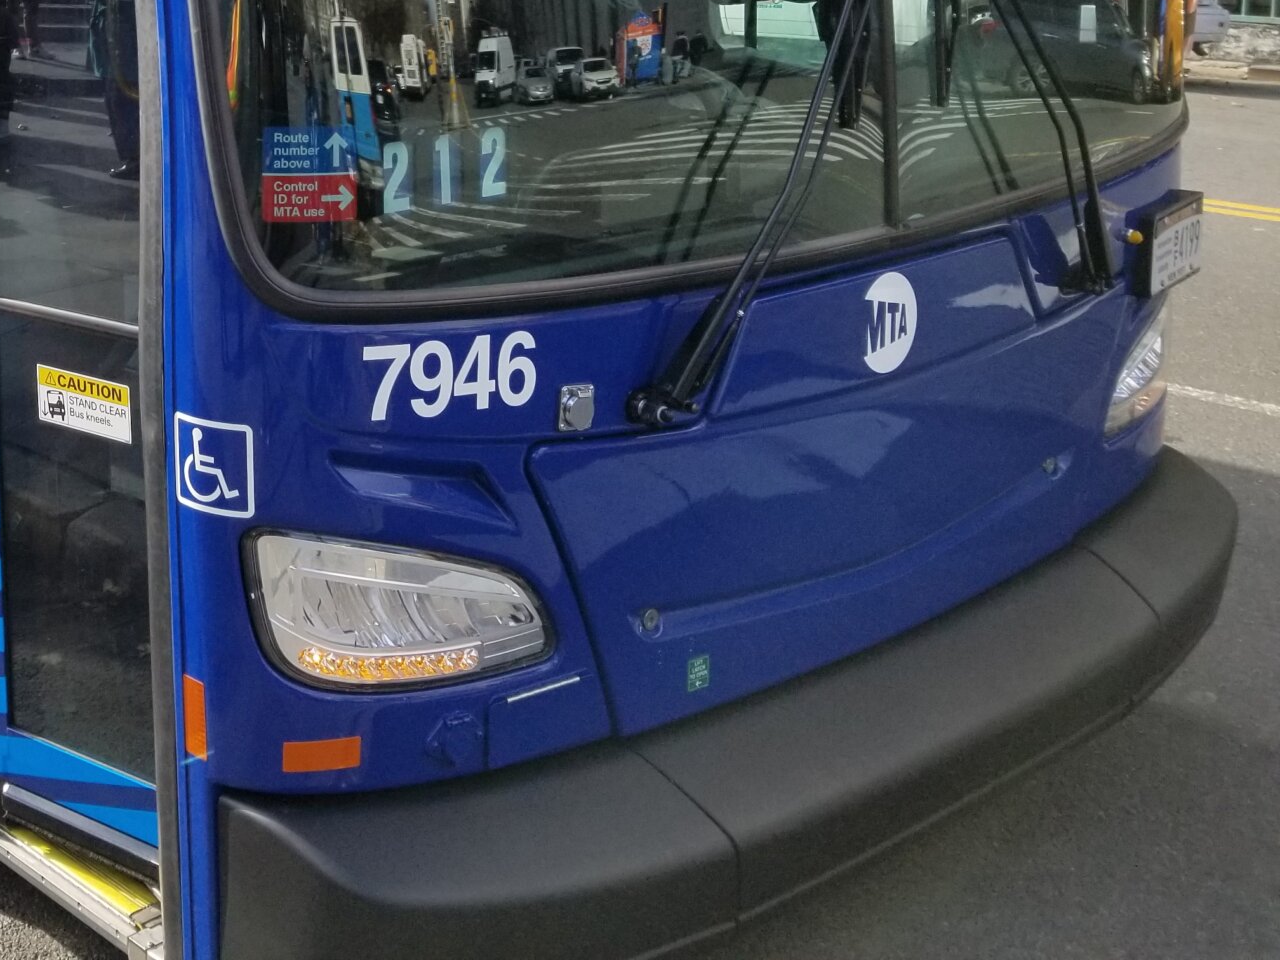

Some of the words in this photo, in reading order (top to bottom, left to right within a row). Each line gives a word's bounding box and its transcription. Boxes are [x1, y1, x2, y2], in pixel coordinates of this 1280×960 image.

[274, 132, 310, 143] Route
[273, 145, 320, 156] number
[273, 158, 311, 169] above
[273, 181, 318, 192] Control
[273, 193, 288, 204] ID
[291, 193, 309, 204] for
[273, 206, 301, 217] MTA
[303, 208, 326, 217] use
[865, 300, 908, 354] MTA
[362, 330, 537, 421] 7946
[57, 373, 122, 403] CAUTION
[68, 395, 97, 411] STAND
[98, 403, 127, 419] CLEAR
[69, 407, 85, 419] Bus
[85, 411, 114, 428] kneels.
